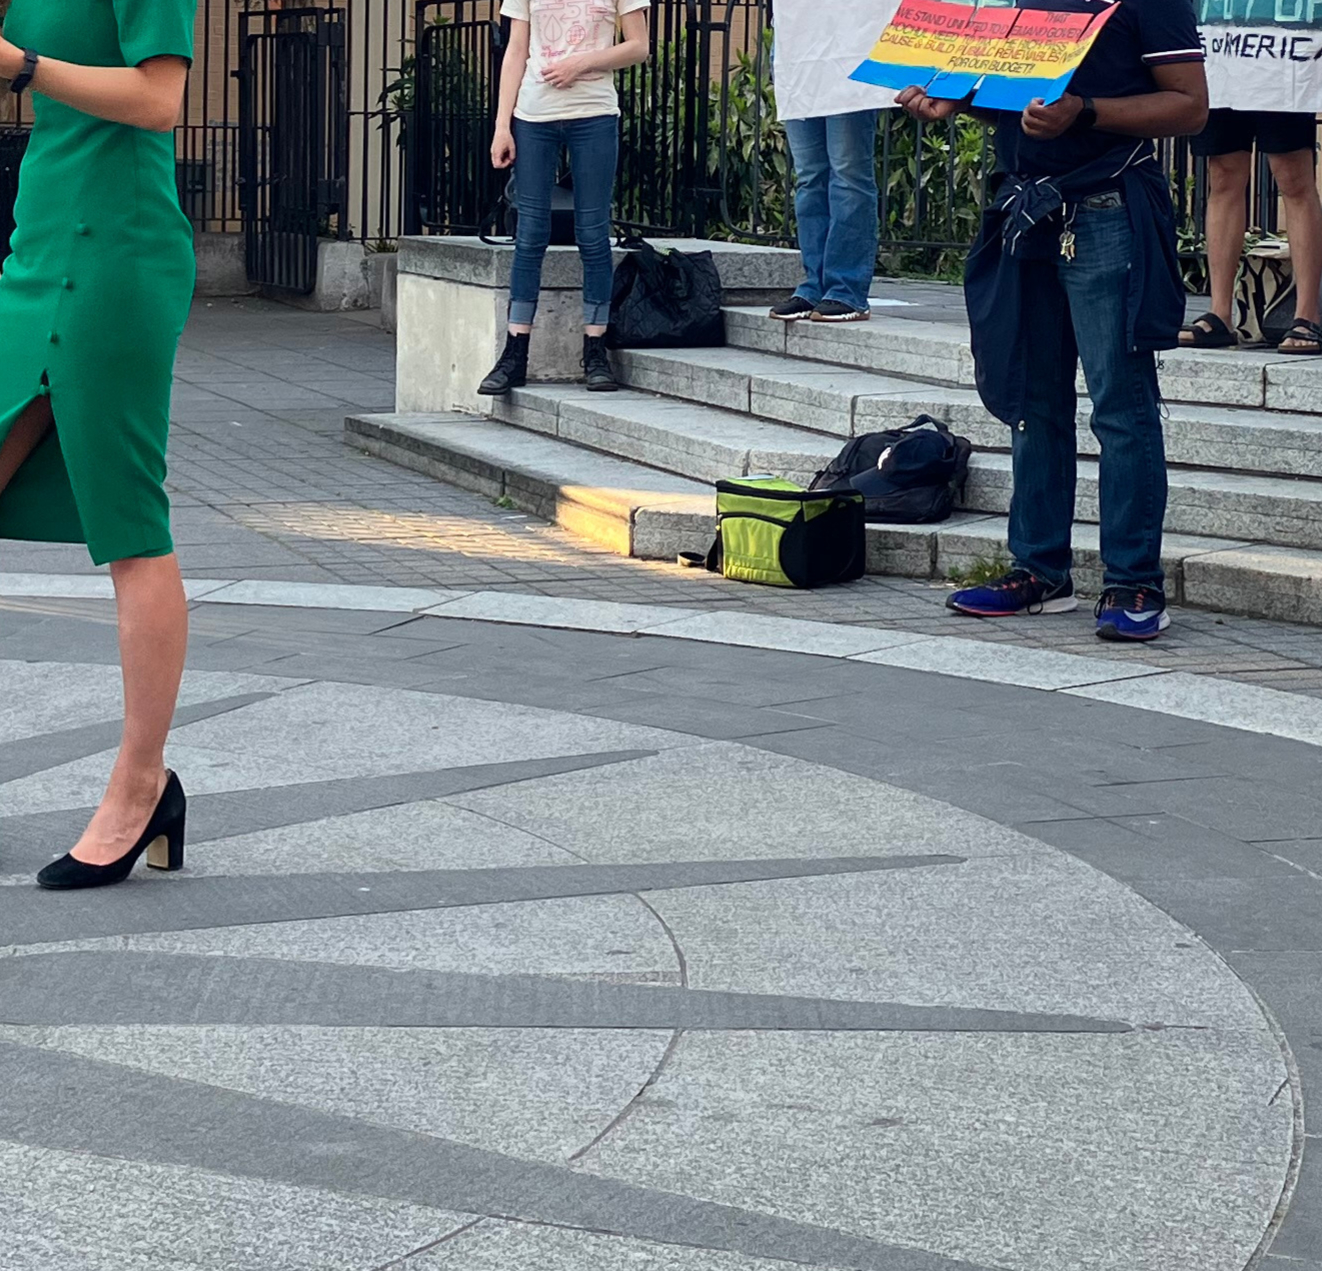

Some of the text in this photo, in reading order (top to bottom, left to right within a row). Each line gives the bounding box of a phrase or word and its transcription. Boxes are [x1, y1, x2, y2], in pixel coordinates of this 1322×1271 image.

[913, 10, 947, 26] STAND
[879, 31, 915, 48] CAUSE
[924, 39, 956, 54] BUILD
[946, 56, 968, 68] FOR
